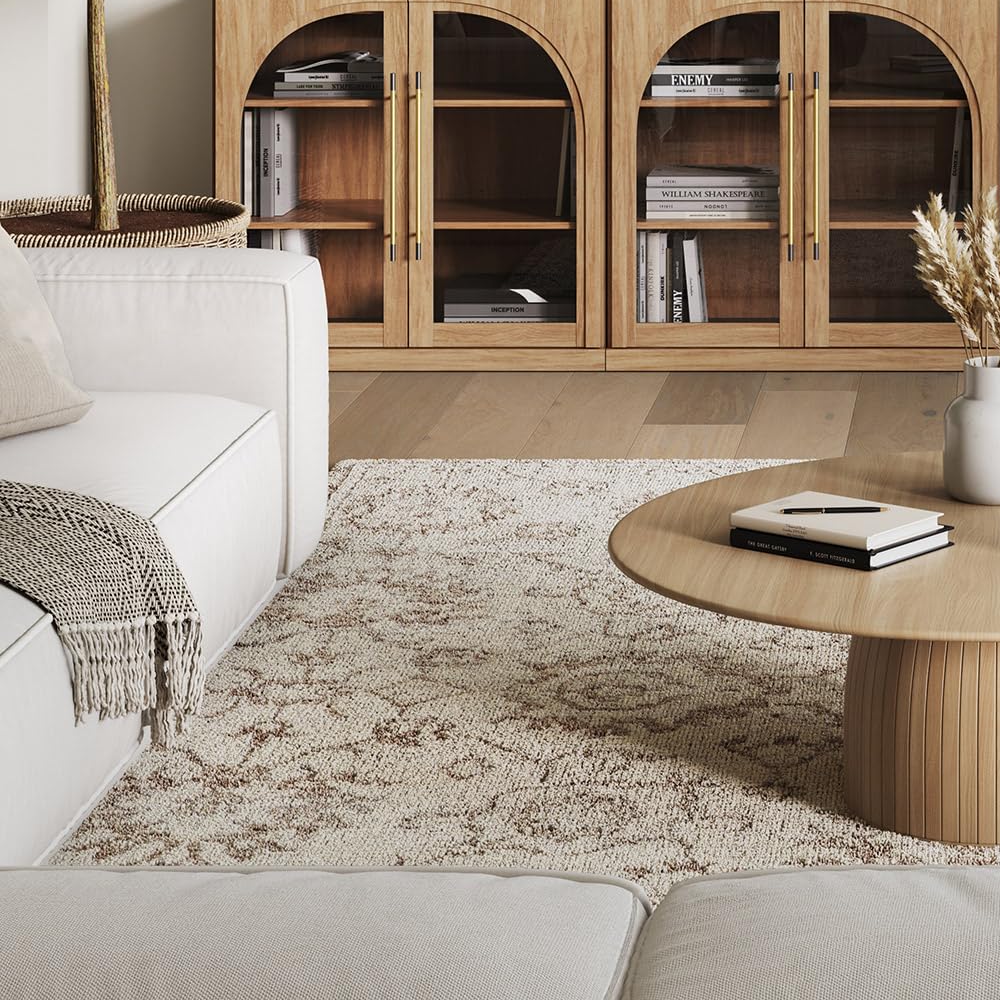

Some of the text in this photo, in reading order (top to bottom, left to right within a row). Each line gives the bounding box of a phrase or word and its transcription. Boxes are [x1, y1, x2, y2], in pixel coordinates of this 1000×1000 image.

[671, 74, 713, 86] ENEMY
[661, 190, 770, 198] WILLIAM SHAKESPEARE
[673, 290, 683, 323] ENEMY
[756, 542, 770, 550] GREAT
[771, 544, 787, 552] GATSBY
[815, 552, 829, 560] SCOTT
[829, 553, 856, 564] FITZGERALD
